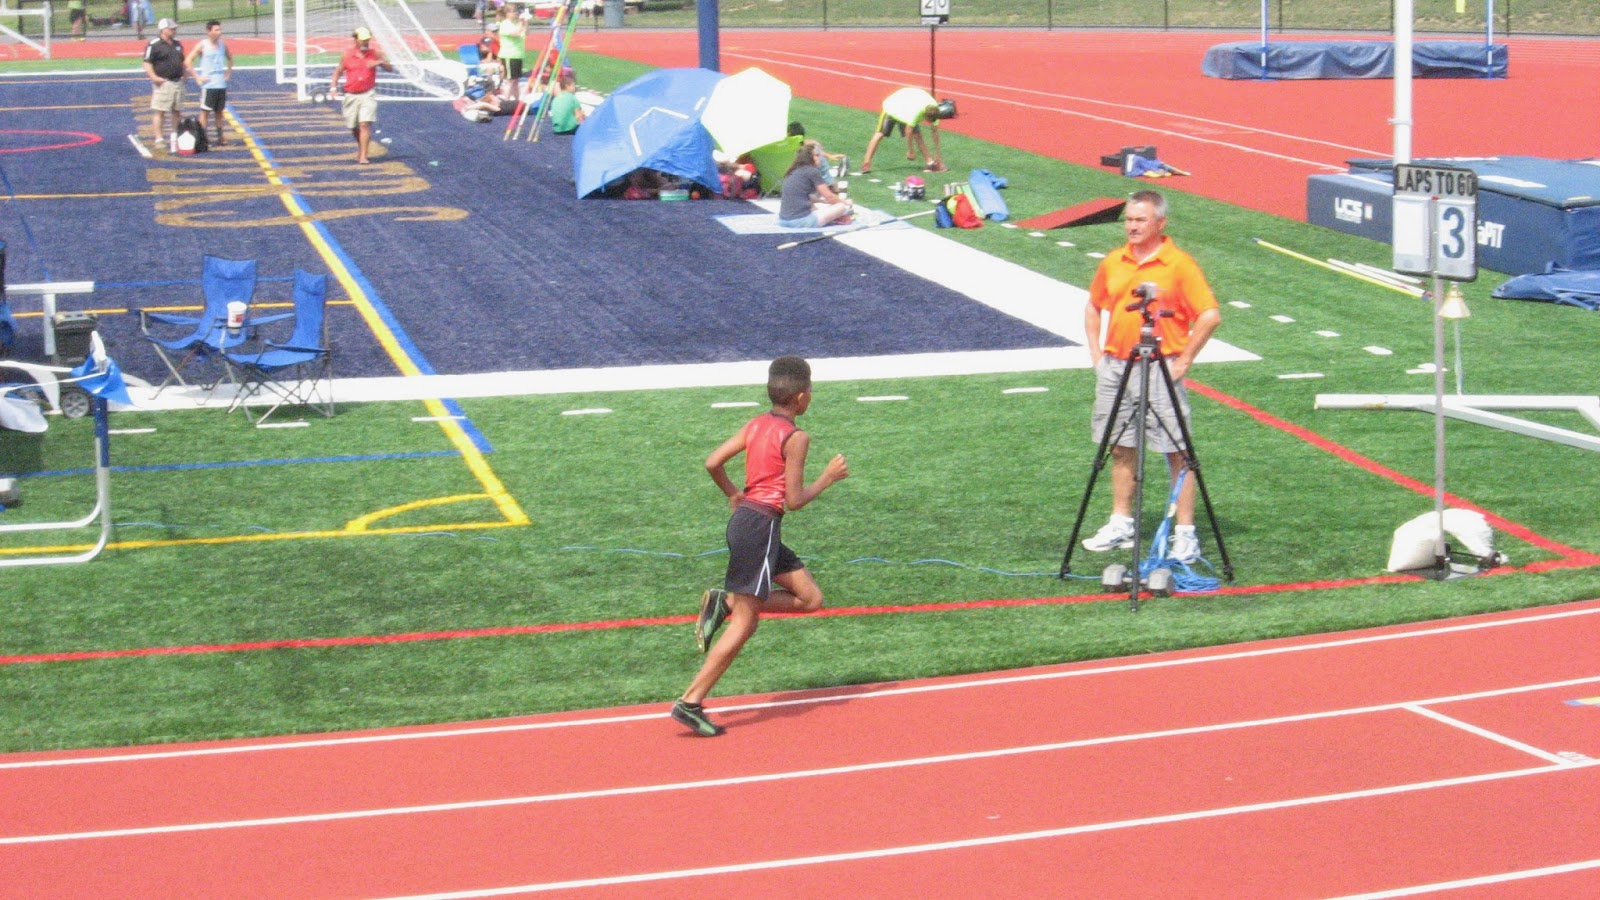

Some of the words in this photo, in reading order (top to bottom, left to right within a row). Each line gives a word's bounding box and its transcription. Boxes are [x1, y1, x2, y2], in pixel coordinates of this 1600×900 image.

[1396, 168, 1432, 193] LAPS
[1436, 171, 1454, 195] TO
[1457, 173, 1477, 197] GO
[1334, 196, 1364, 218] UCS
[1442, 206, 1465, 259] 3
